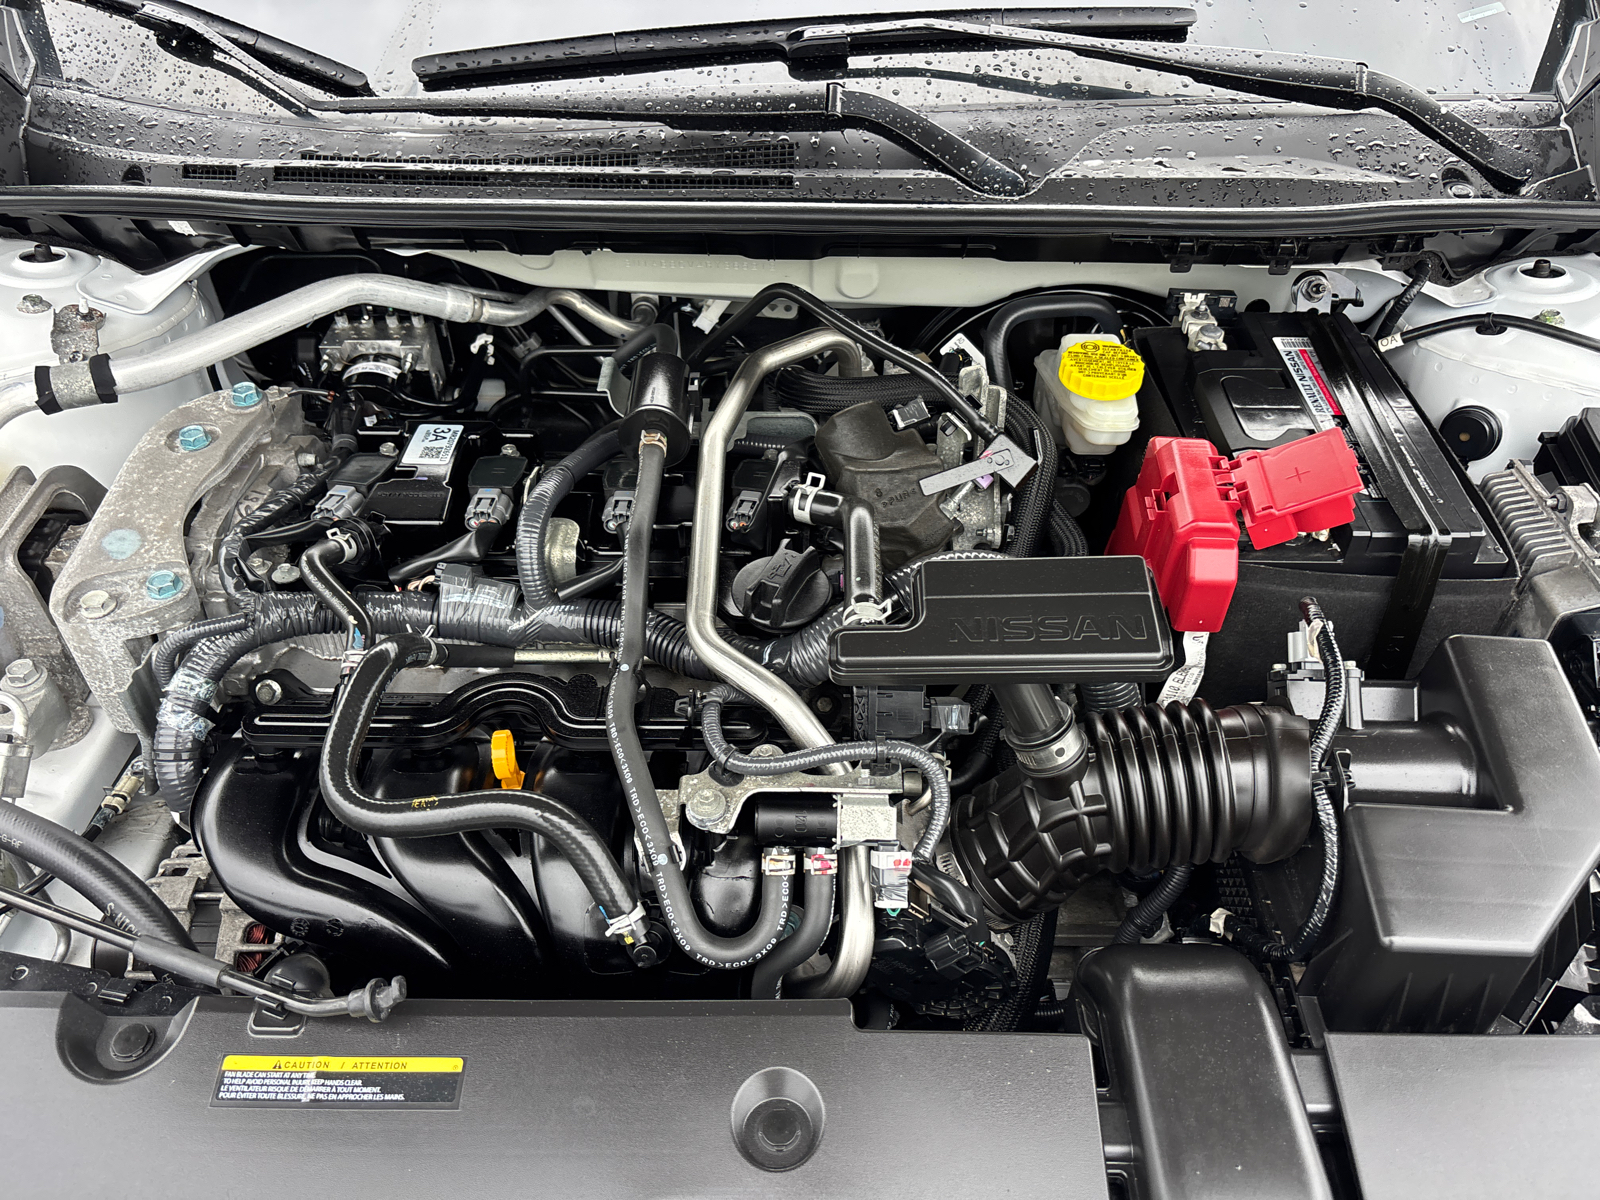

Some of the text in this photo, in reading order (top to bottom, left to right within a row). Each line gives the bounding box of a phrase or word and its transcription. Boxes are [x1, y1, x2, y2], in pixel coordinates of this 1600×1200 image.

[1283, 350, 1307, 382] NISSAN
[1301, 383, 1326, 414] RENAULT
[429, 428, 451, 442] 3A
[949, 615, 1147, 642] NISSAN
[284, 1060, 330, 1069] CAUTION
[352, 1062, 407, 1070] ATTENTION
